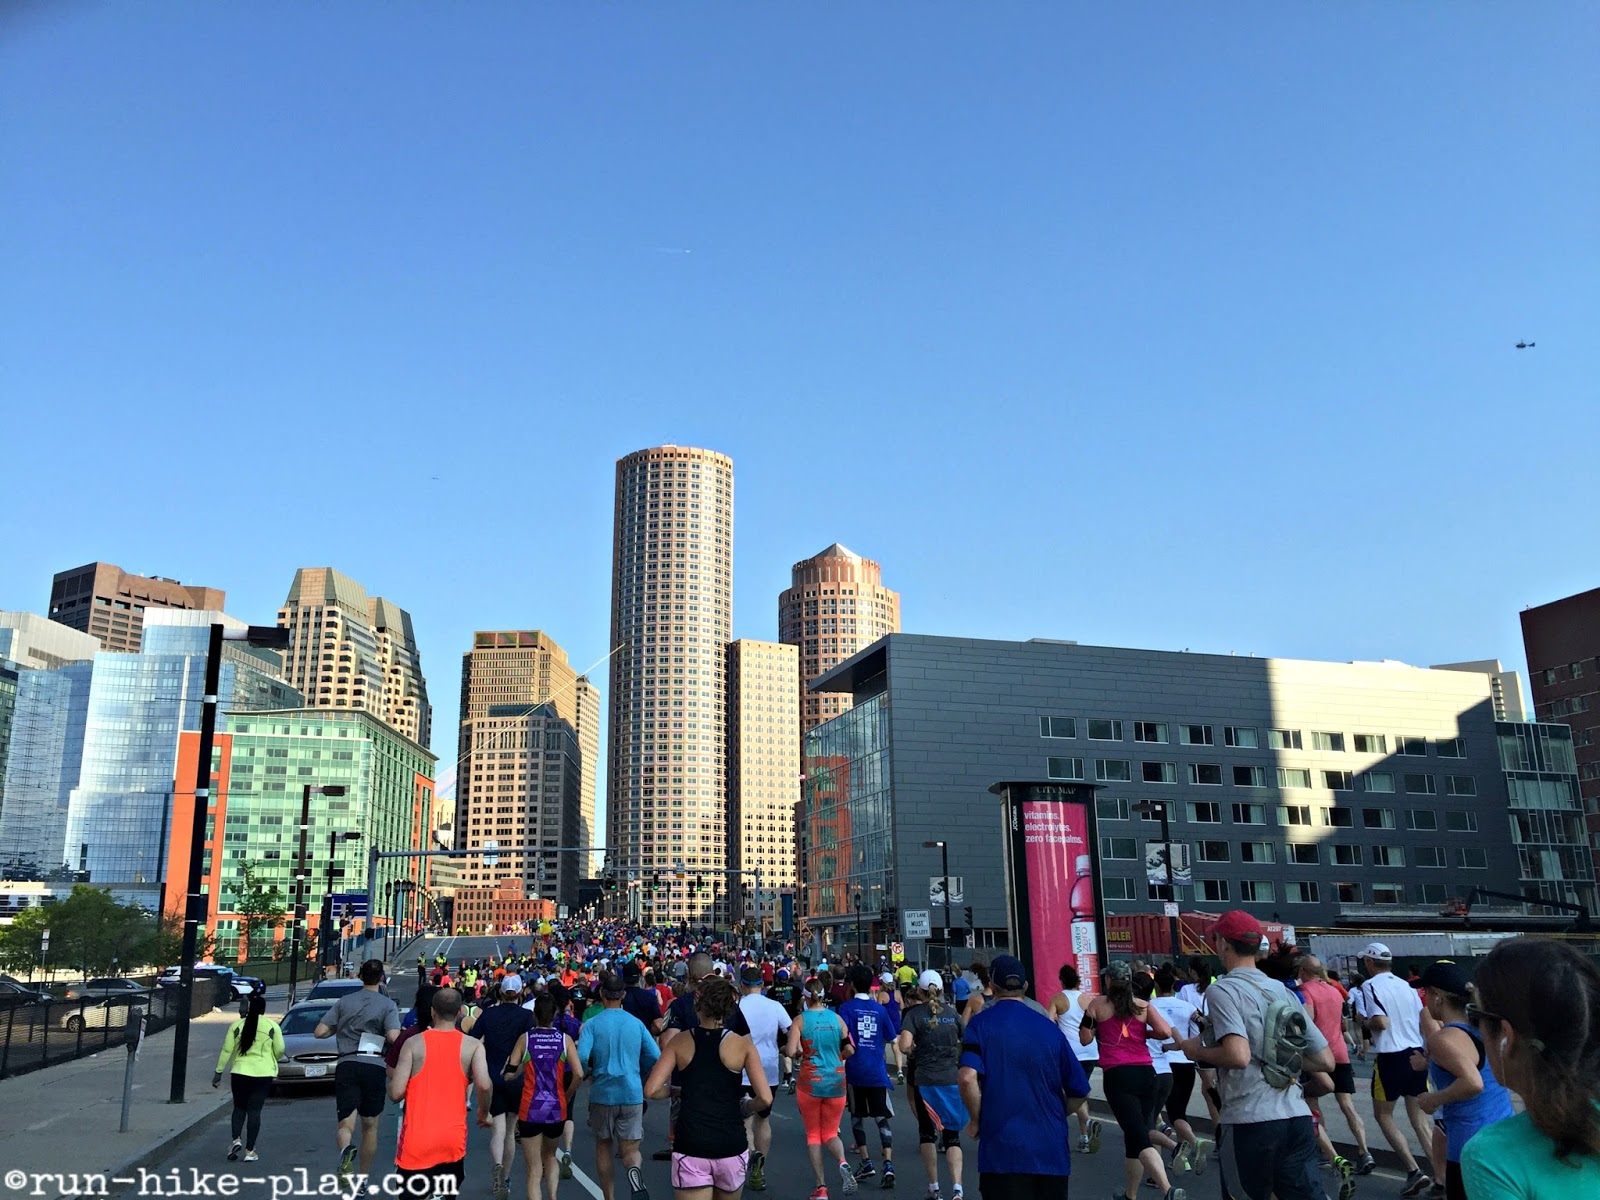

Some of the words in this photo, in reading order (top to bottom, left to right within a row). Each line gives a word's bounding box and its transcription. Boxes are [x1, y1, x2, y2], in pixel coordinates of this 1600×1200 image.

[1058, 786, 1077, 795] MAP
[1024, 811, 1060, 820] vitamins.
[1024, 822, 1072, 833] electrolytes.
[1025, 835, 1044, 843] zero
[1045, 834, 1083, 844] facepalms.
